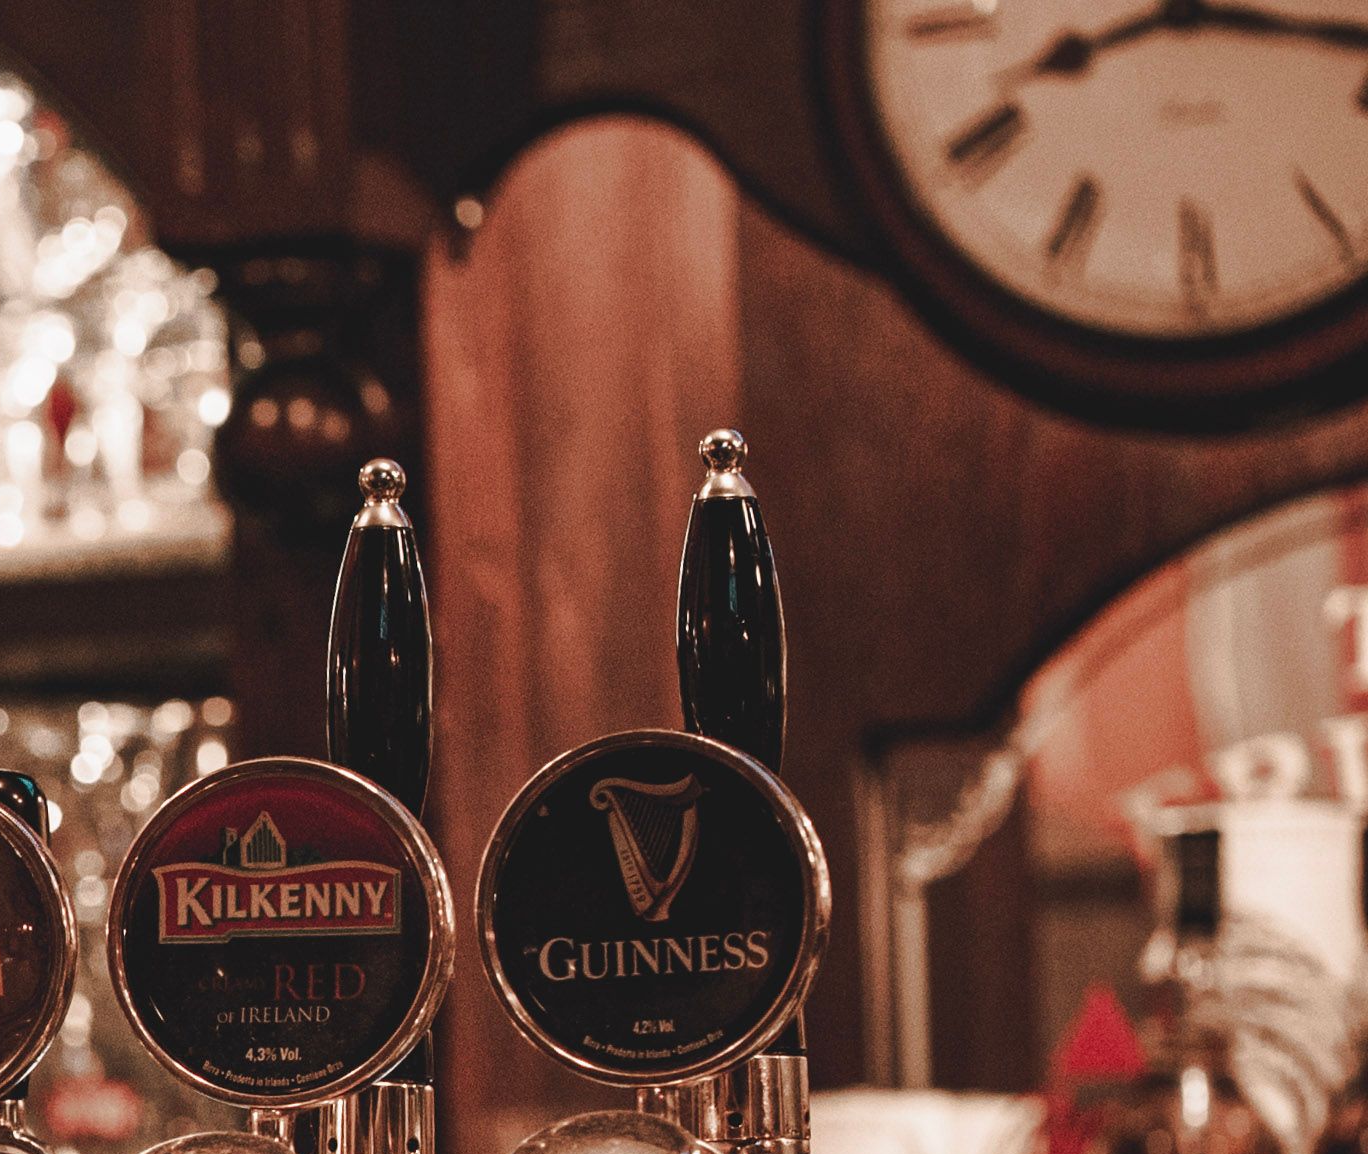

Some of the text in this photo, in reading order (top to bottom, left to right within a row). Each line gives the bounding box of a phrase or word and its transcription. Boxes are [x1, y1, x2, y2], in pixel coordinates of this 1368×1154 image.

[175, 877, 388, 926] KILKENNY
[538, 930, 770, 982] GUINNESS
[273, 963, 366, 1001] RED
[240, 1005, 331, 1025] IRELAND
[280, 1046, 302, 1061] Vol.
